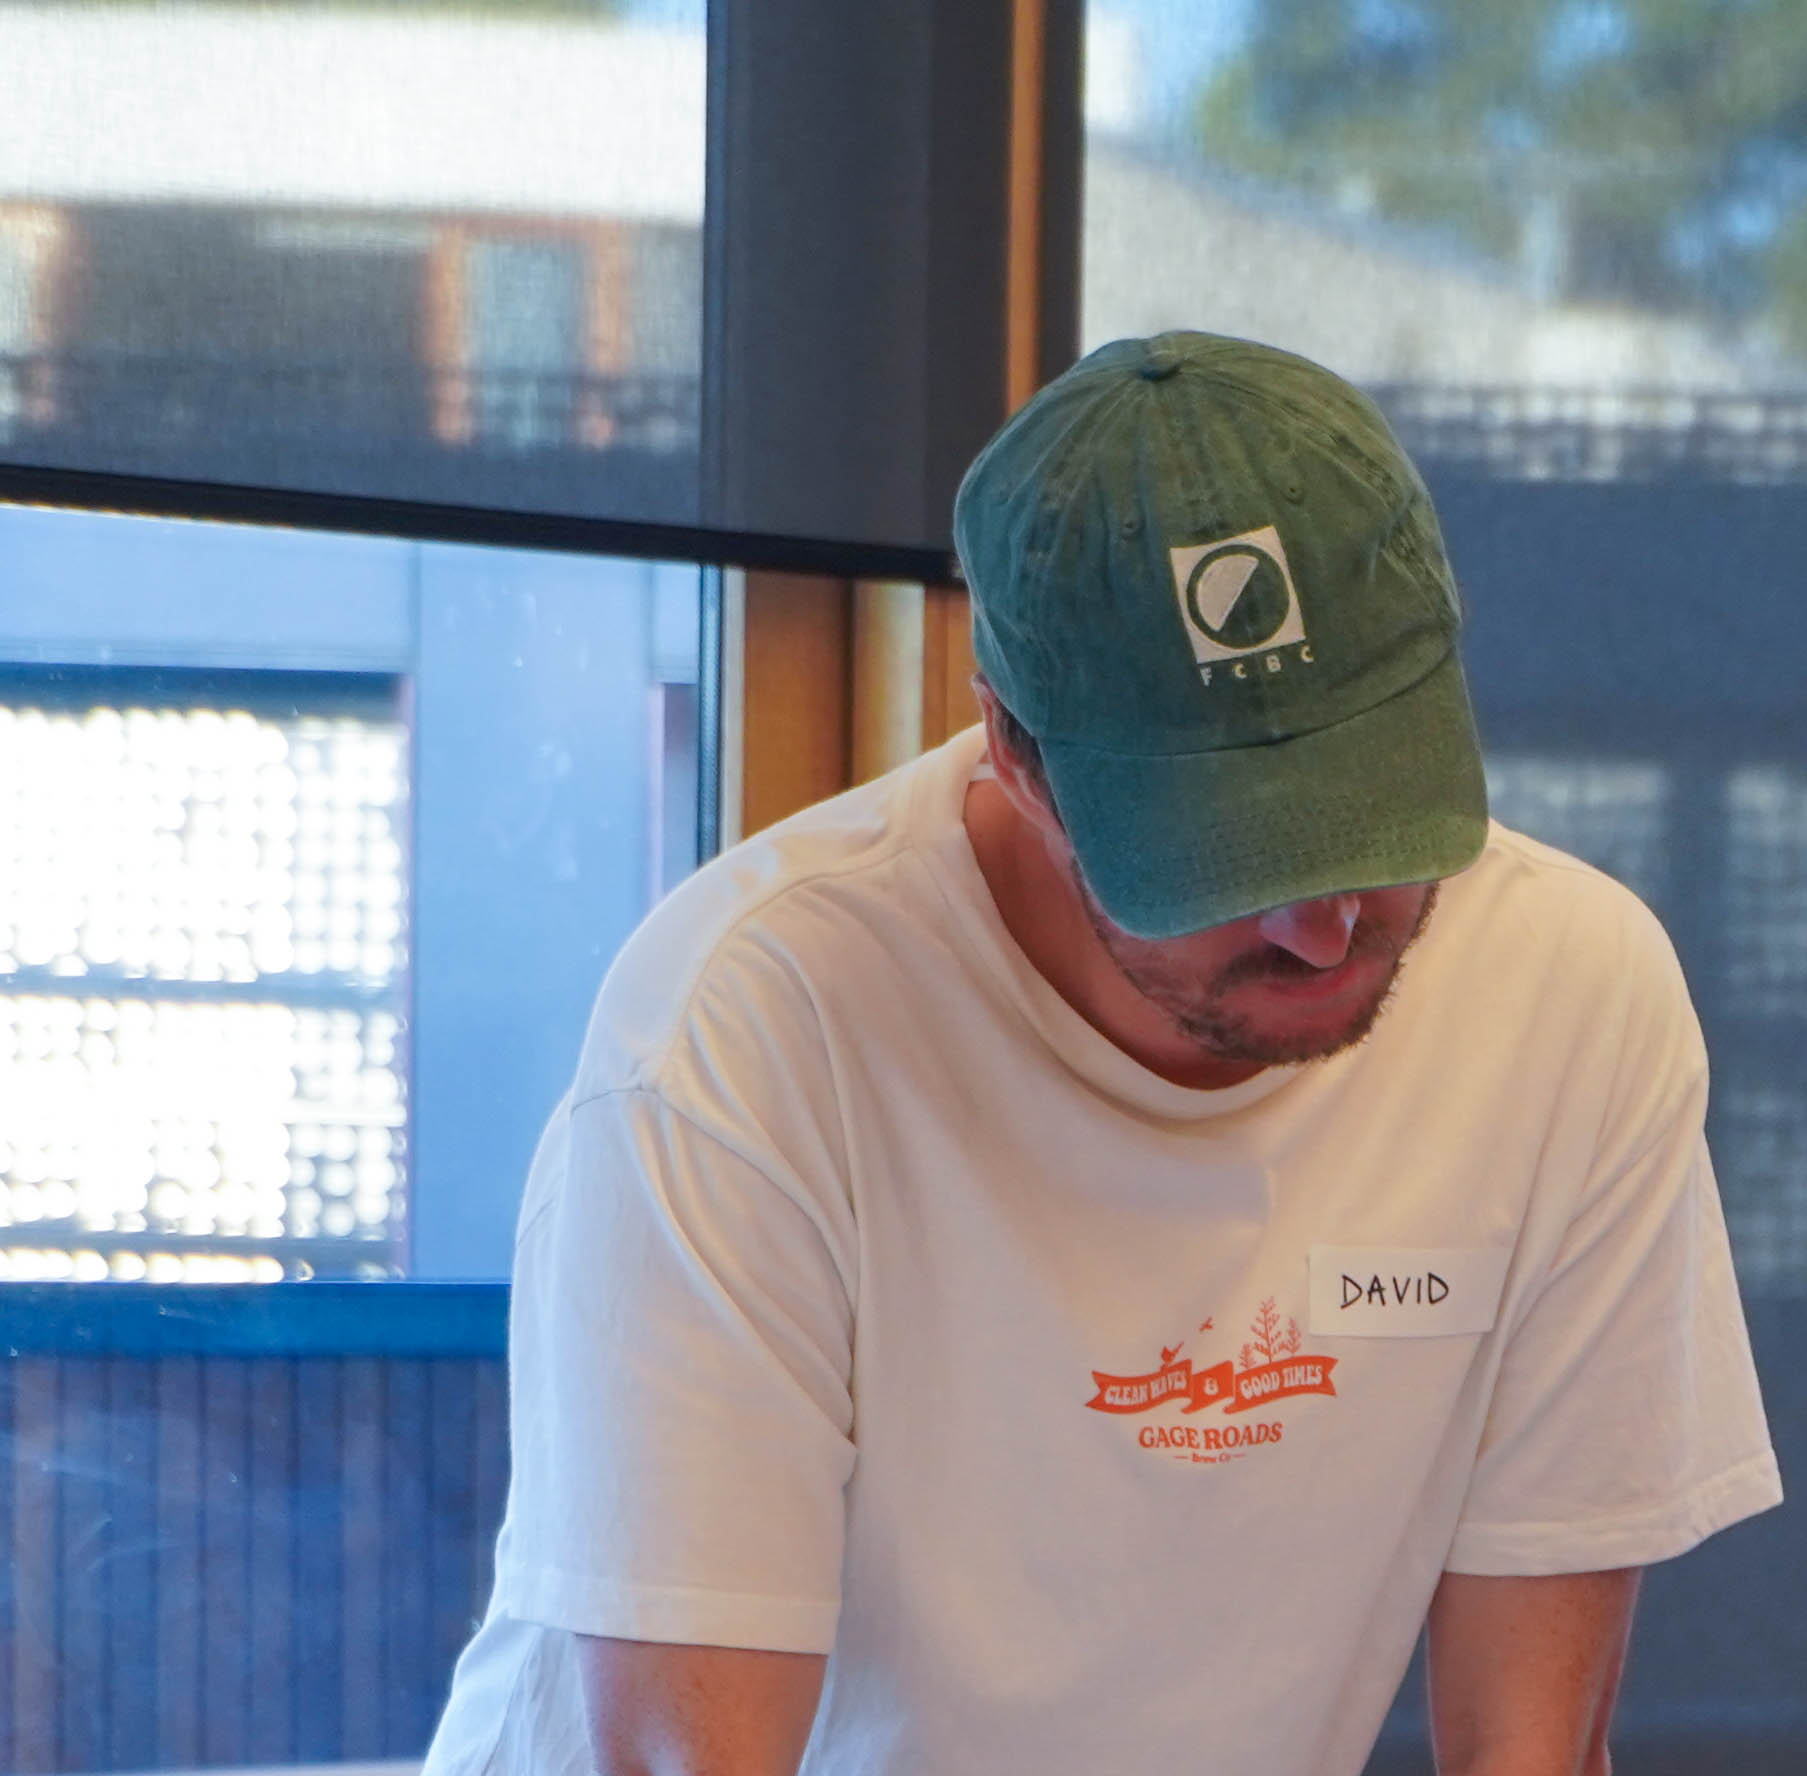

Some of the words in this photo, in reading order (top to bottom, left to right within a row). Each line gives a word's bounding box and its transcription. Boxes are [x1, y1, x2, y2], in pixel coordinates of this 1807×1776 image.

[1340, 1272, 1449, 1309] DAVID
[1104, 1383, 1149, 1405] CLEAN
[1150, 1371, 1187, 1399] WAVES
[1203, 1377, 1219, 1396] &
[1239, 1372, 1281, 1400] GOOD
[1283, 1365, 1323, 1388] TIMES
[1138, 1424, 1201, 1450] GAGE
[1203, 1422, 1283, 1450] ROADS
